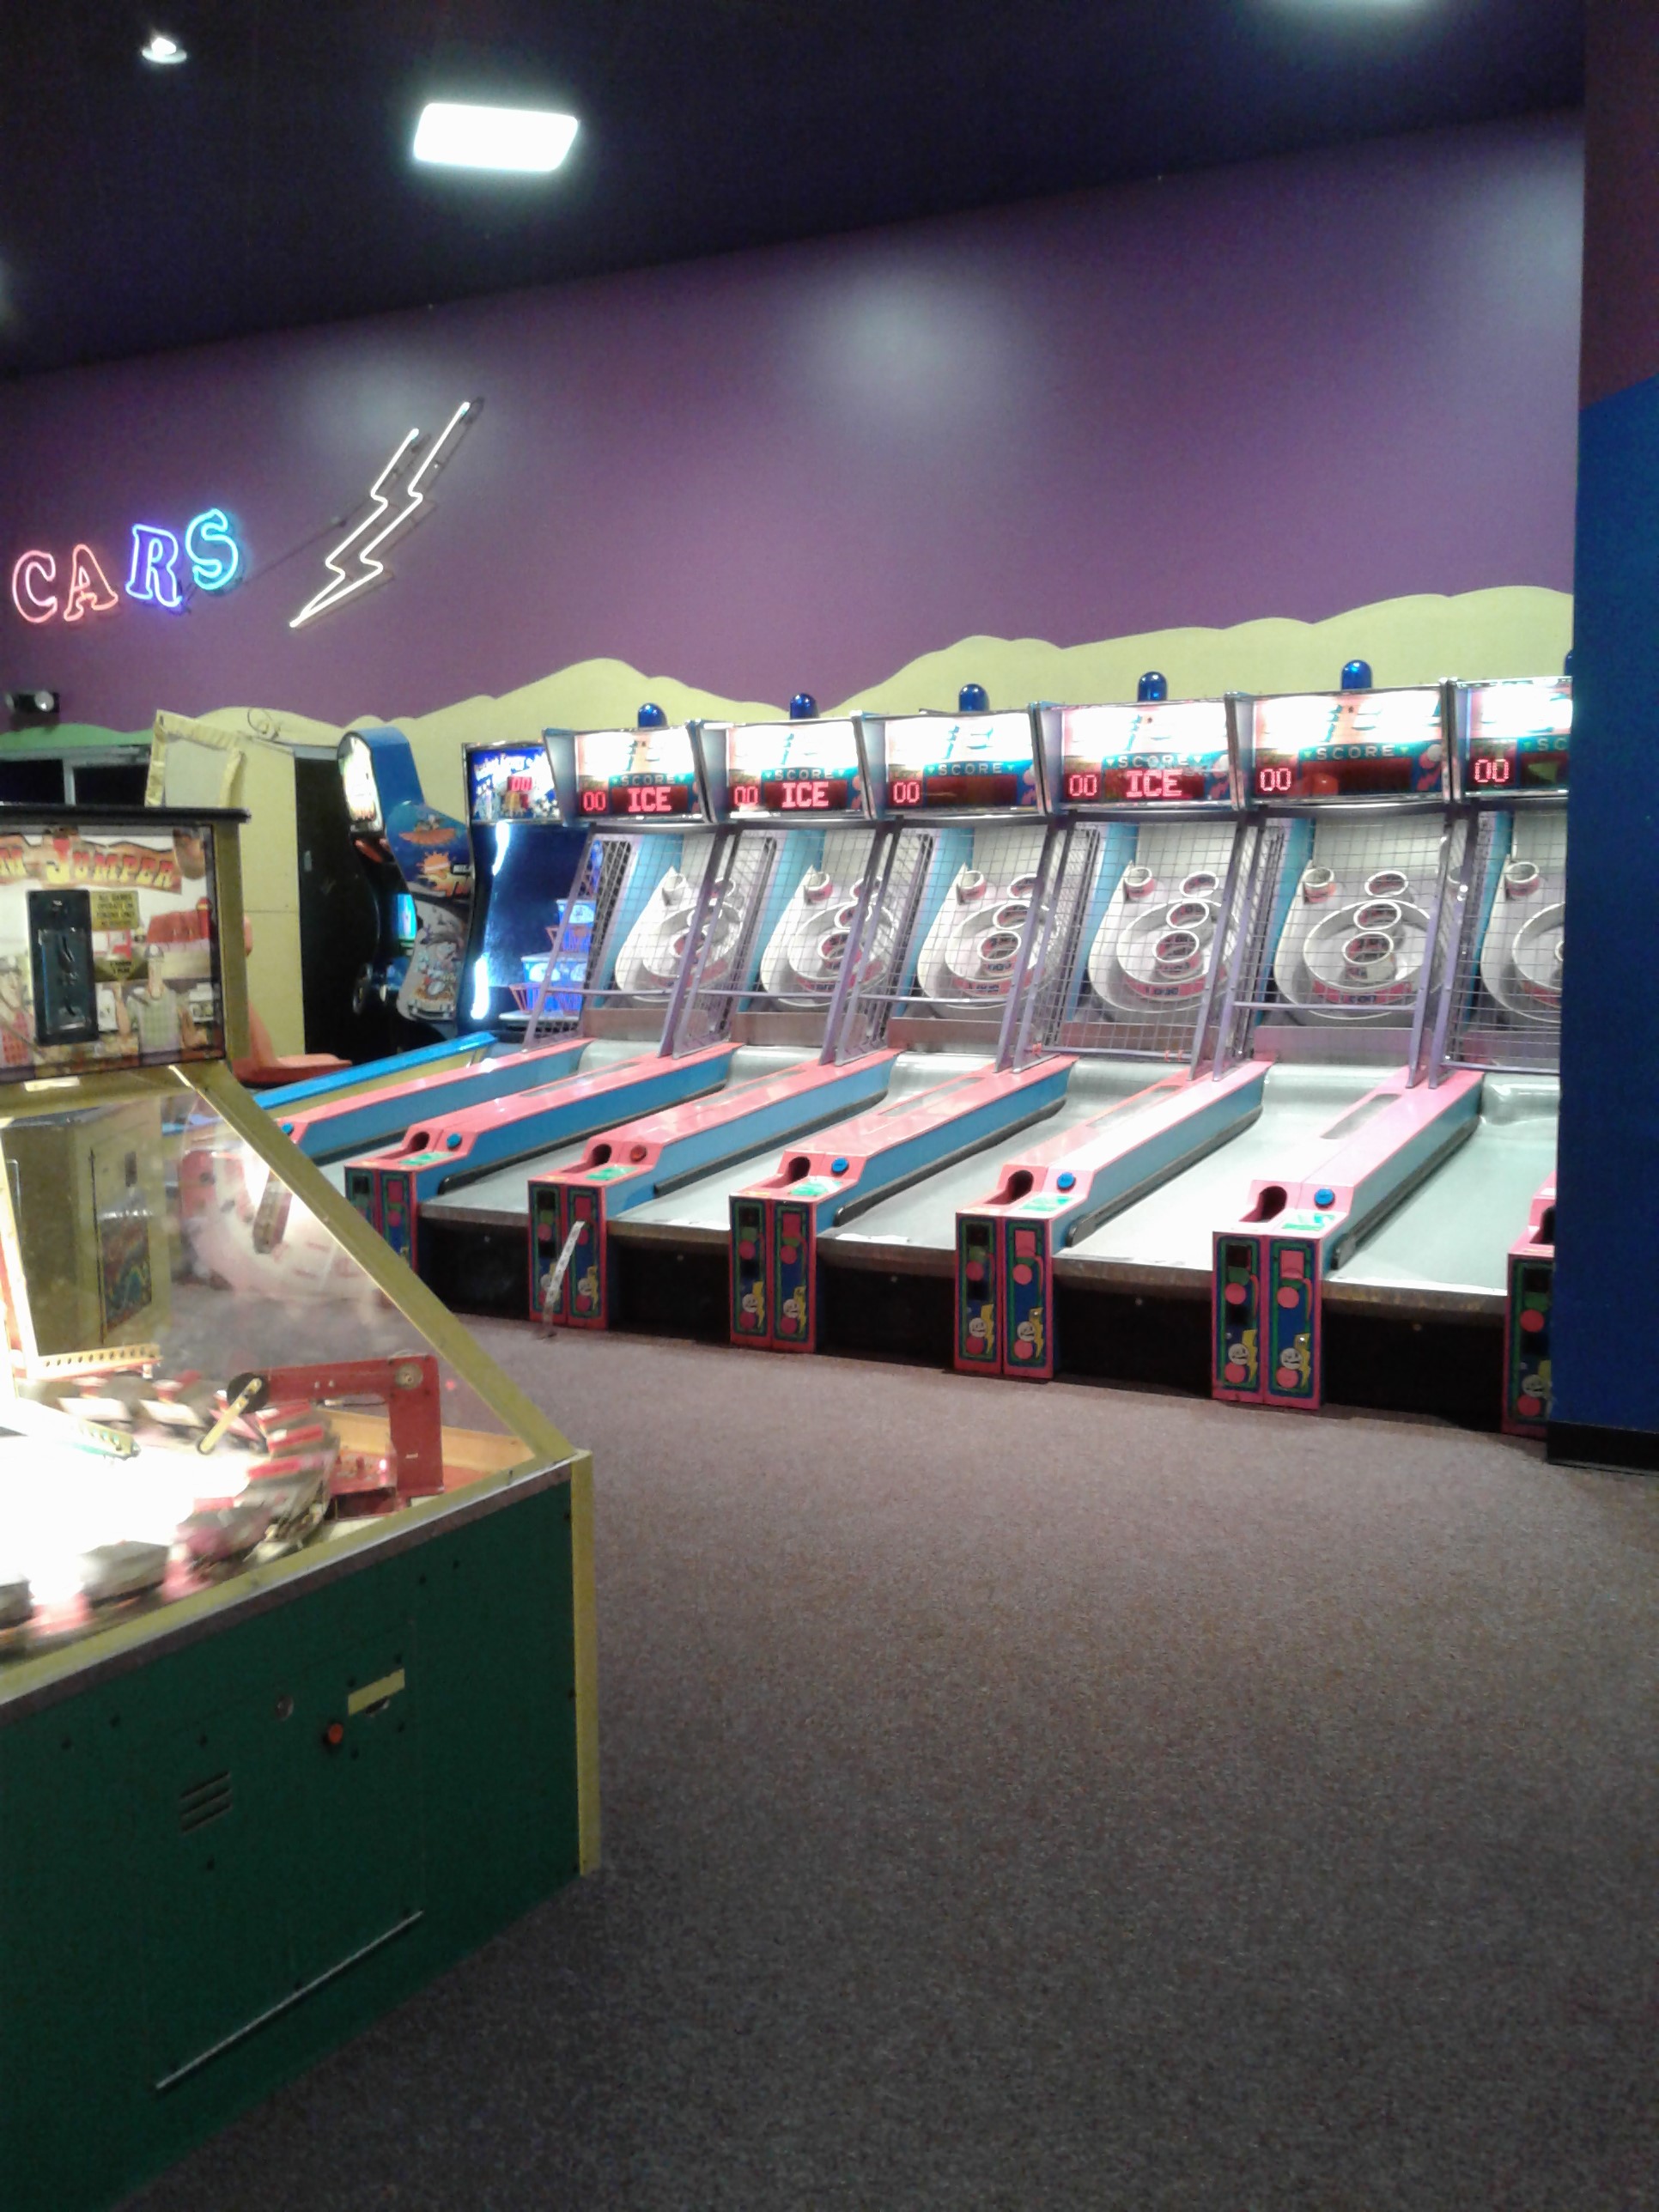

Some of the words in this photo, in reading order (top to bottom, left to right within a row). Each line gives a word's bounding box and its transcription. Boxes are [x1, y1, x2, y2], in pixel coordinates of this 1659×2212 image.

[13, 508, 239, 624] CARS
[1118, 754, 1188, 769] SCORE
[1316, 744, 1395, 760] SCORE
[621, 774, 676, 787] SCORE
[939, 763, 1003, 776] SCORE
[1261, 768, 1291, 791] 00
[1474, 759, 1510, 782] 00
[893, 781, 921, 804] 00
[1069, 775, 1097, 797] 00
[1127, 769, 1183, 798] ICE
[583, 791, 606, 811] 00
[628, 787, 672, 812] ICE
[734, 786, 758, 806] 00
[781, 781, 830, 809] ICE
